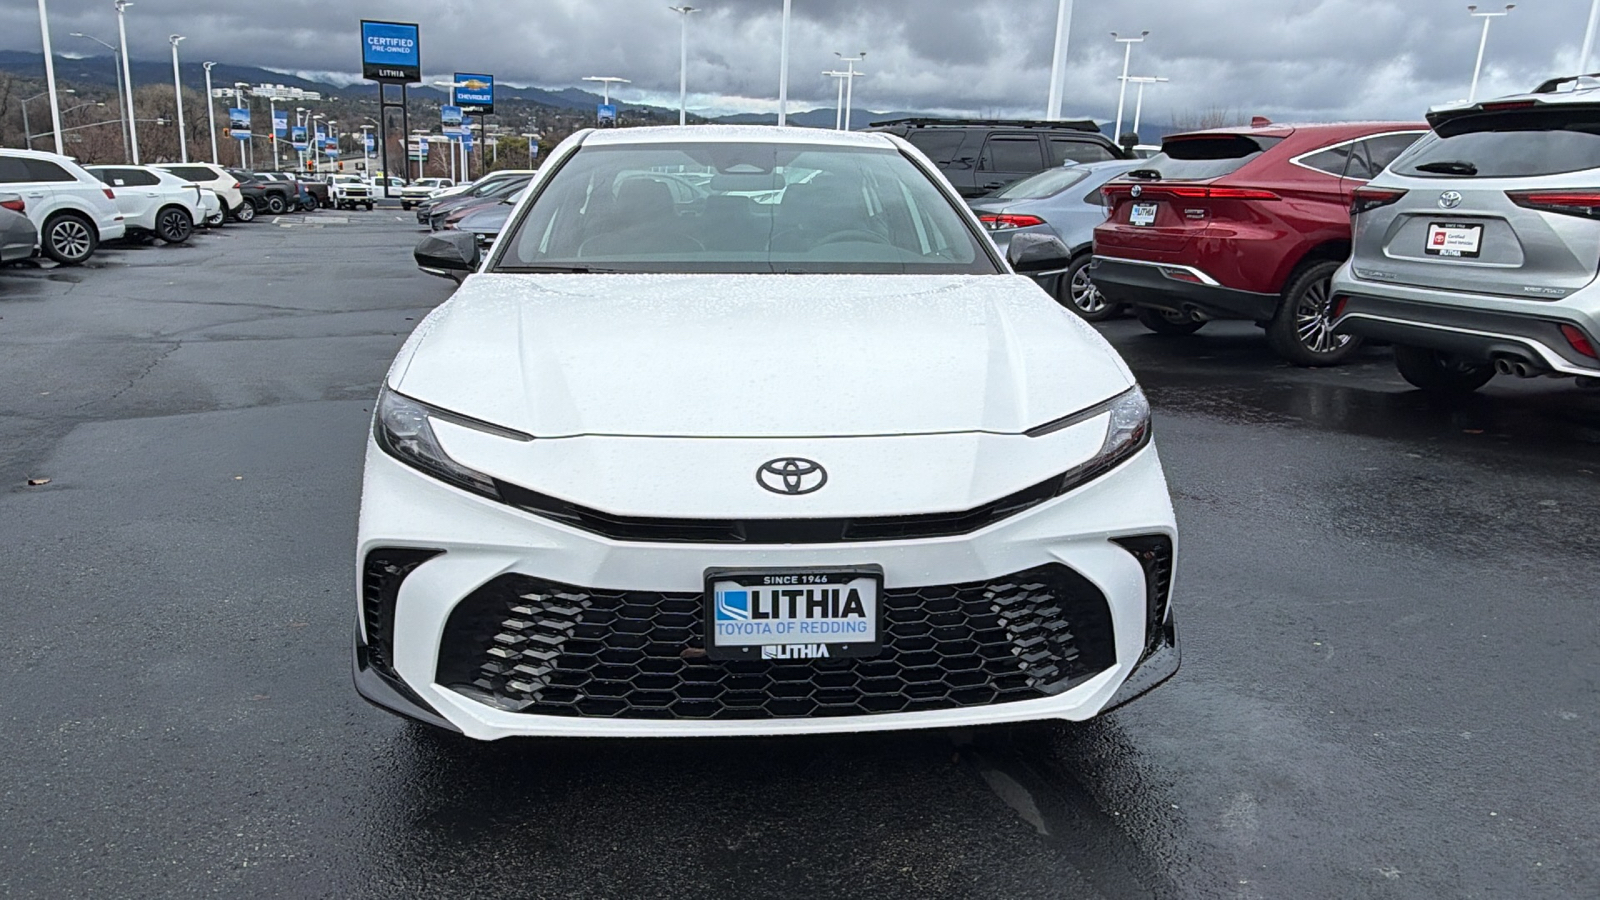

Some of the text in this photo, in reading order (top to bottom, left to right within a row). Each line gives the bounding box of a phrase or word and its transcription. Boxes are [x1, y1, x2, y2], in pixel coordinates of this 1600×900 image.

[367, 36, 414, 47] CERTIFIED
[371, 45, 411, 54] PRE-OWNED
[379, 69, 405, 78] LITHIA
[457, 93, 491, 101] CHEVROLET
[763, 575, 828, 585] SINCE 1946
[751, 588, 866, 620] LITHIA
[717, 621, 867, 636] TOYOTA OF REDDING
[776, 644, 830, 659] LITHIA
